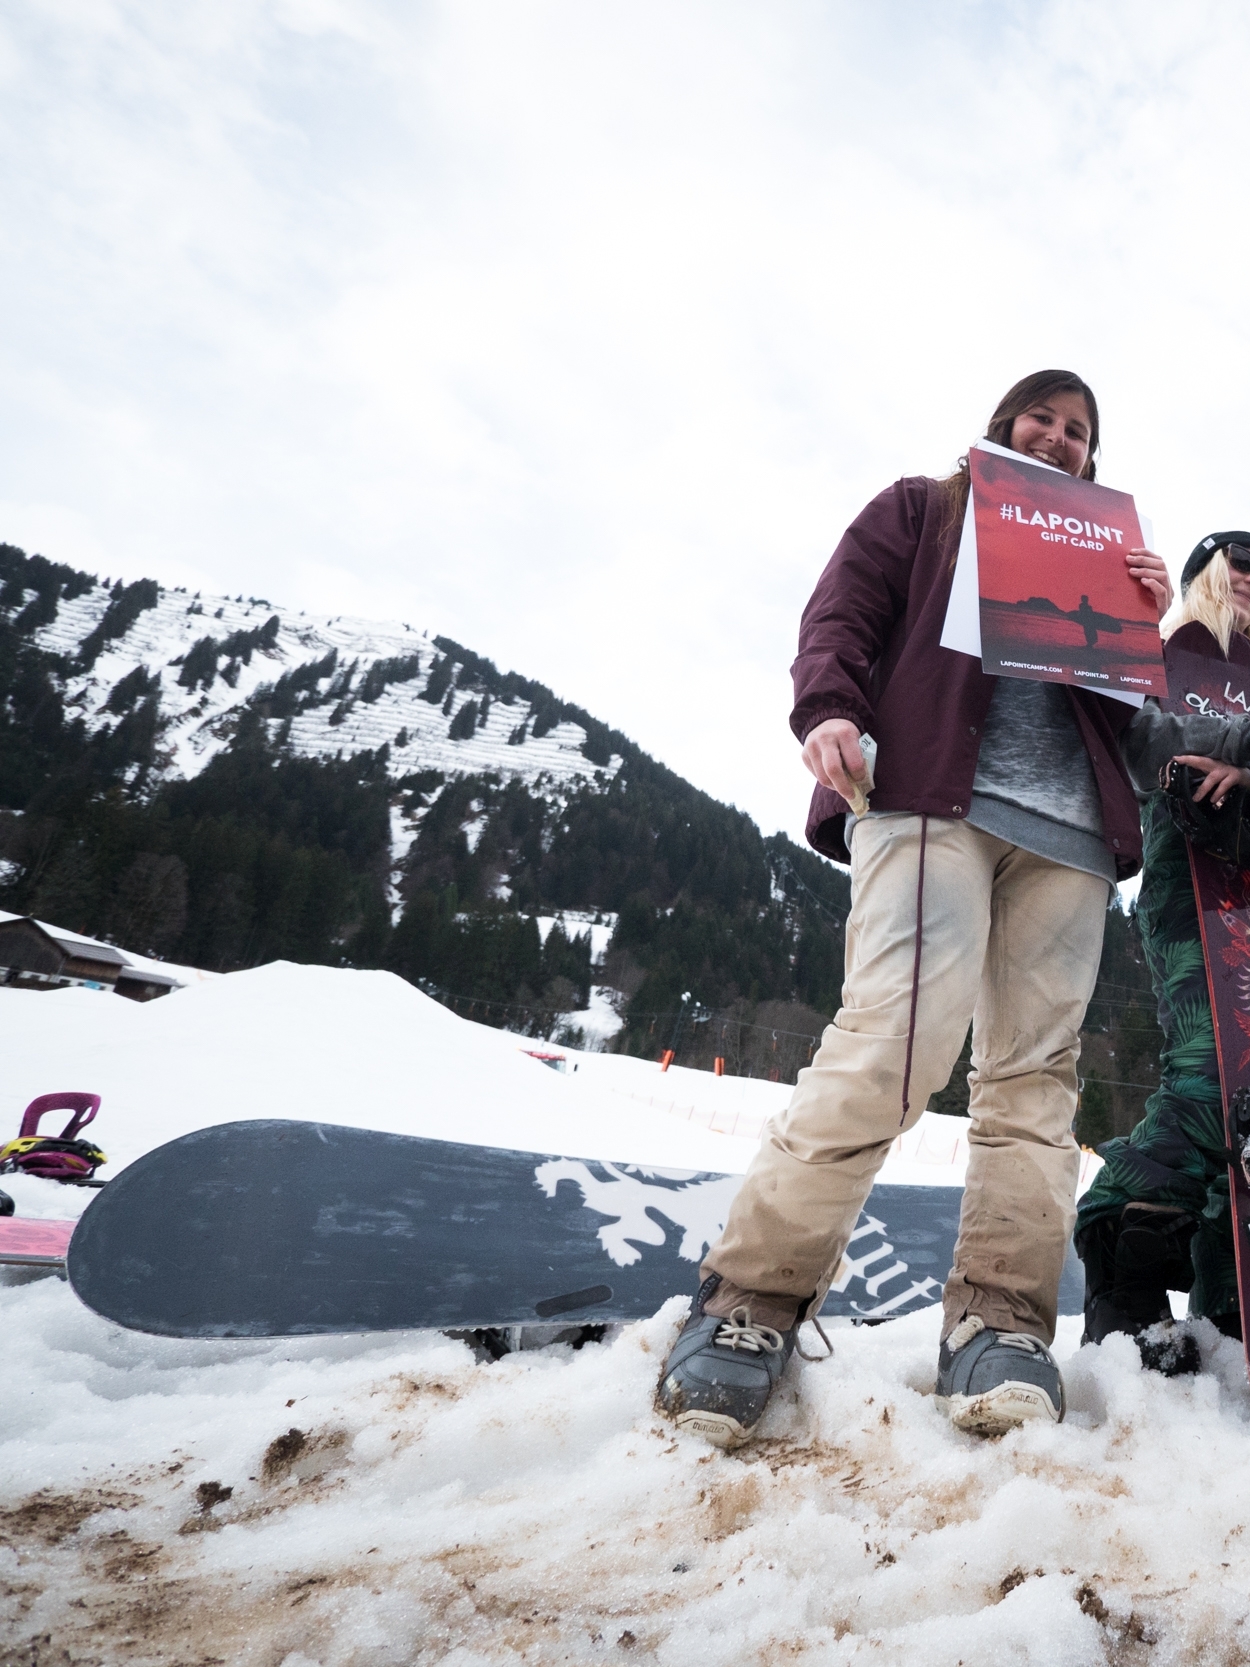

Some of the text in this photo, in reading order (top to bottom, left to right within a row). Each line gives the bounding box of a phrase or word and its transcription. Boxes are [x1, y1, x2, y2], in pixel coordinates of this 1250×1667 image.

[1000, 503, 1124, 545] #LAPOINT
[1041, 531, 1105, 551] GIFT CARD
[1000, 660, 1153, 686] LAPOINTCAMPS.COM LAPOINT.NO LAPOINT.SE
